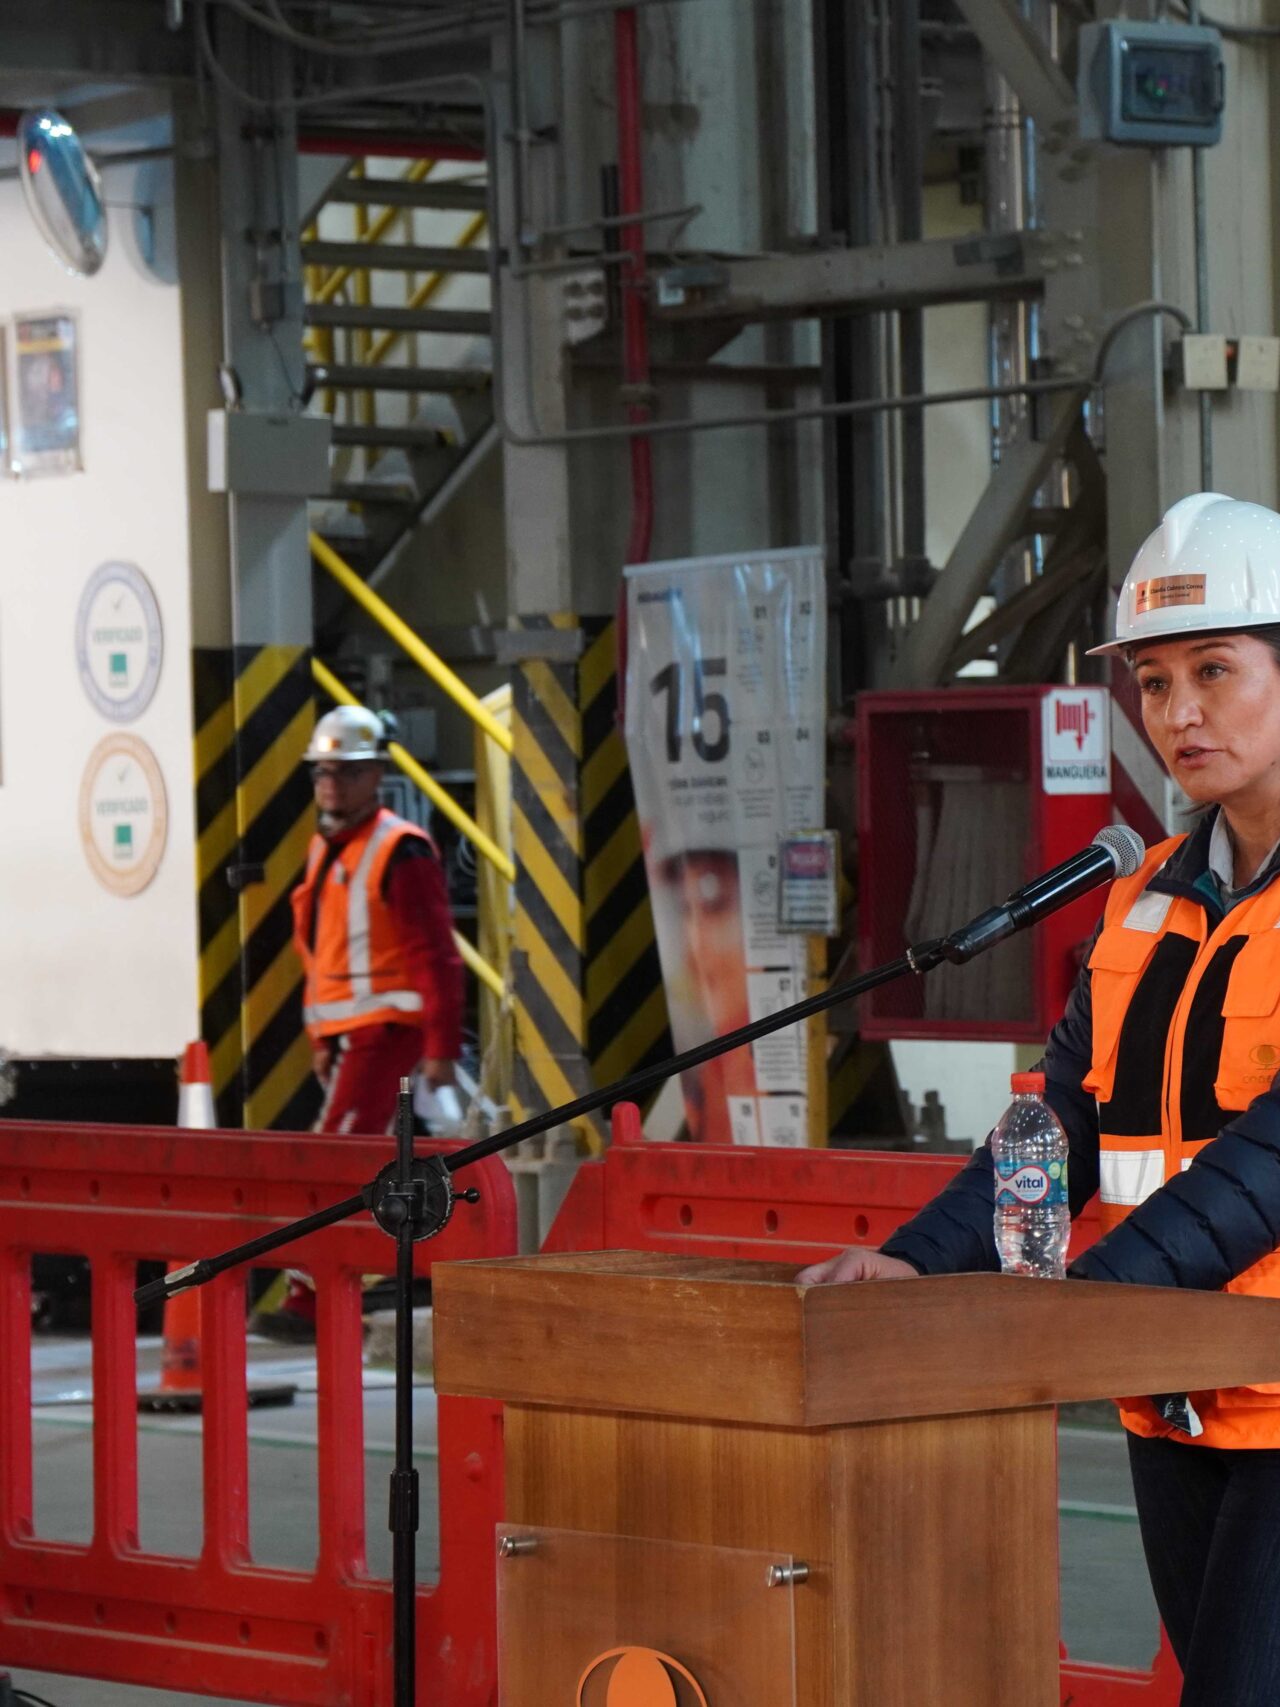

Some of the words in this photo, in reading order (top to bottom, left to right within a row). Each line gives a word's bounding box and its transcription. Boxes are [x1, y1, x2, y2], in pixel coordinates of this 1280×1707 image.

[651, 658, 730, 763] 15
[1046, 765, 1107, 779] MANGUERA
[1015, 1175, 1043, 1189] vital
